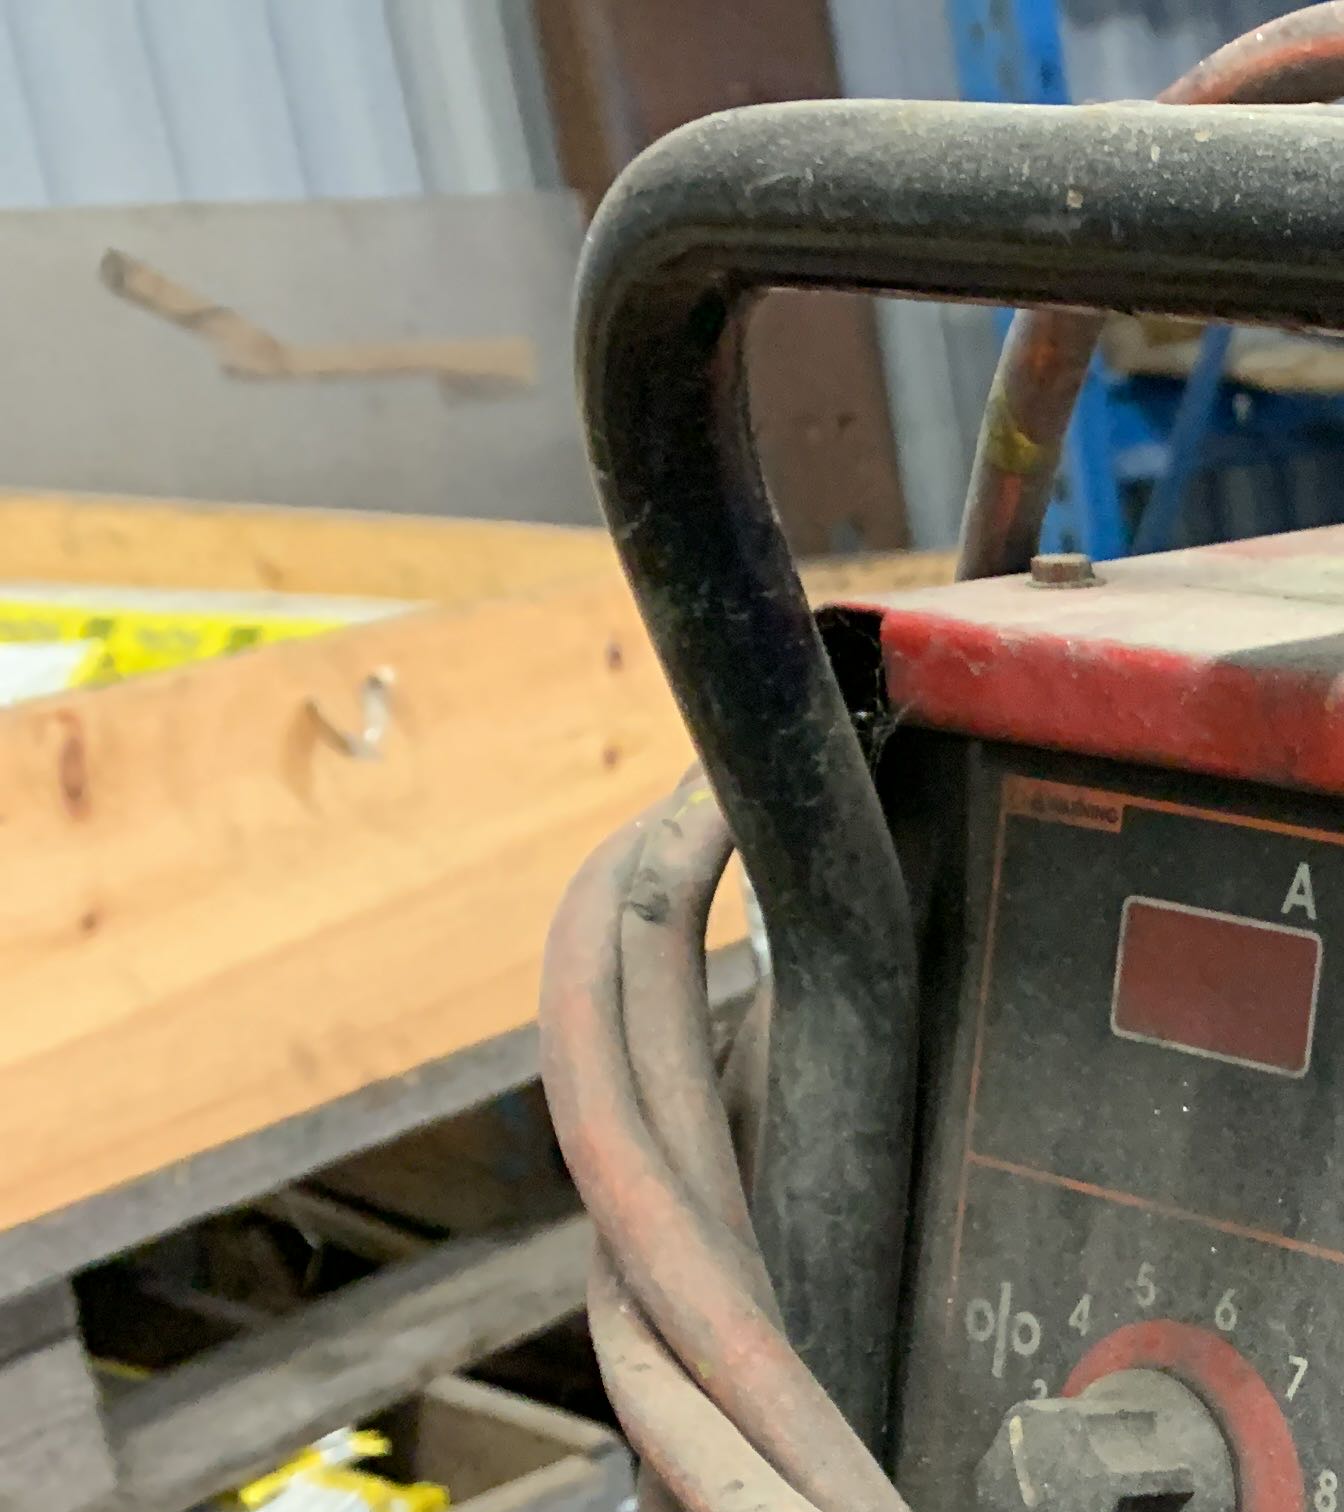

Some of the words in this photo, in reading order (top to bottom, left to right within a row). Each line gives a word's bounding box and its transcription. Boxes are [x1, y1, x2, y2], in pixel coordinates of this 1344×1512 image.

[1280, 861, 1317, 920] A
[1136, 1261, 1156, 1308] 5
[1068, 1293, 1092, 1337] 4
[1214, 1287, 1237, 1332] 6
[1284, 1354, 1308, 1401] 7
